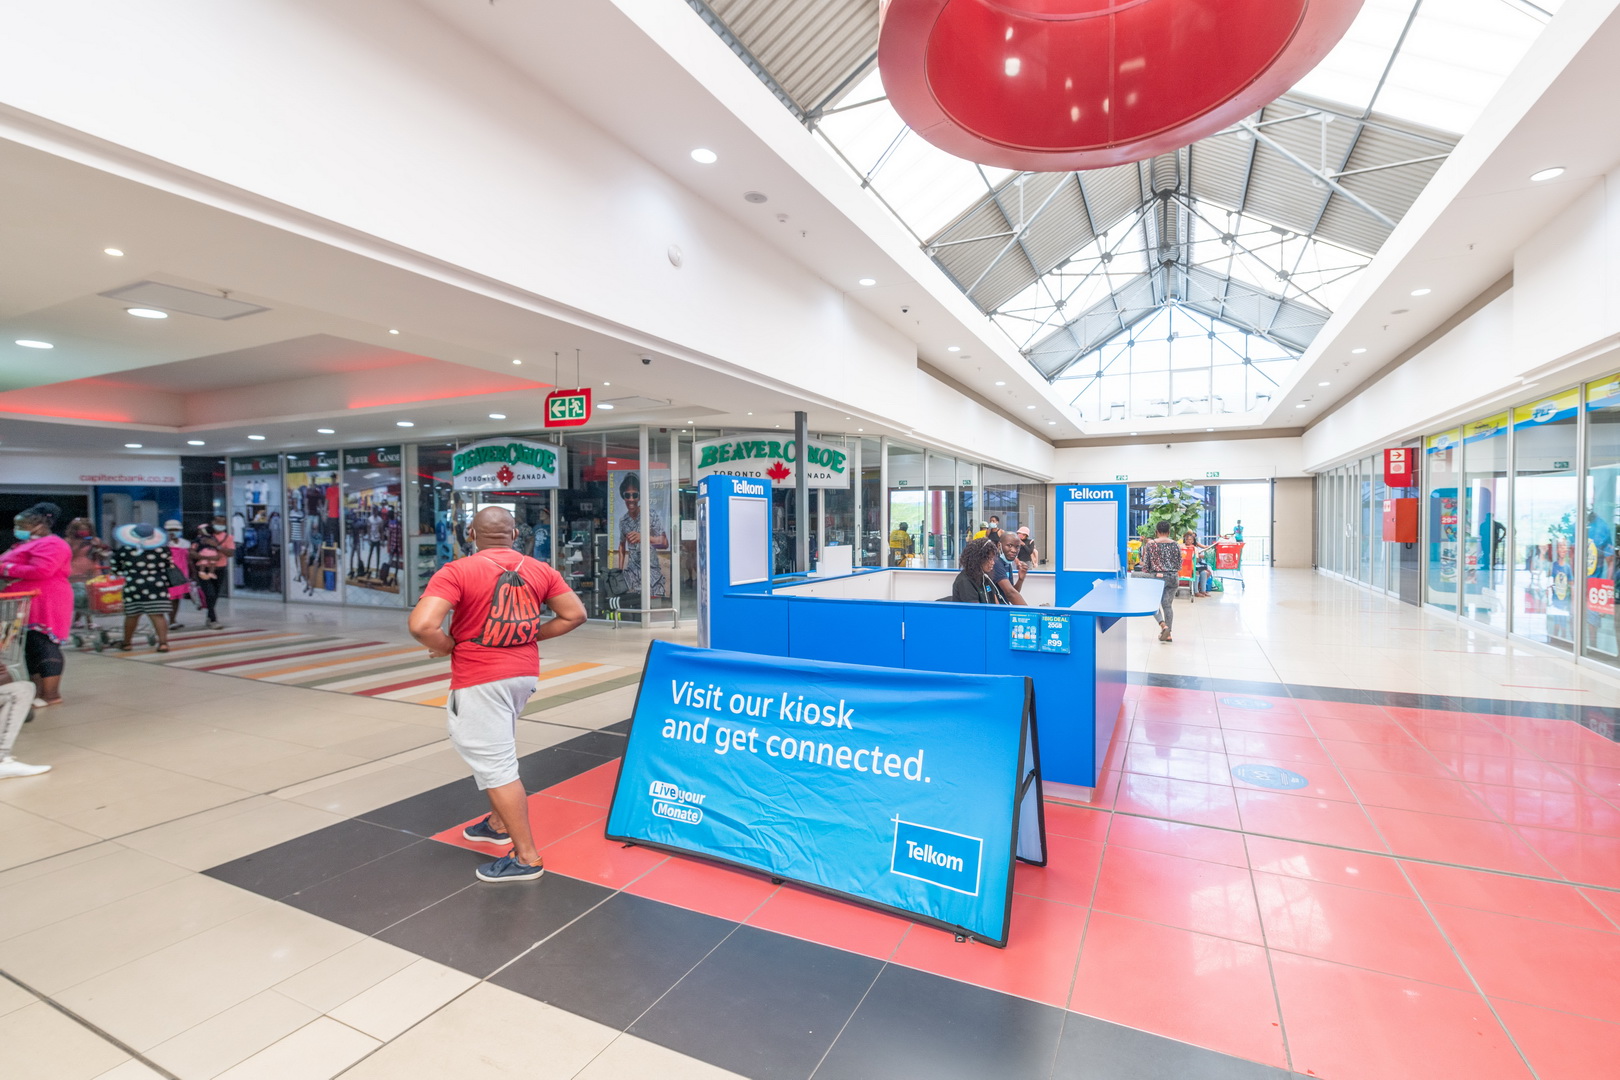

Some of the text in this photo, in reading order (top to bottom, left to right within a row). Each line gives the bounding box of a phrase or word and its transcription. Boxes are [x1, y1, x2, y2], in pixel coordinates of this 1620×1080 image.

[289, 458, 310, 468] BEAVER
[346, 455, 369, 464] BEAVER
[453, 443, 557, 477] BEAVER CANOE
[697, 440, 847, 474] BEAVER CNOE
[233, 462, 253, 471] BEAVER
[714, 470, 762, 478] TORONTO
[731, 479, 764, 495] Telkom
[1069, 488, 1114, 499] Telkom
[1588, 587, 1608, 605] 69
[482, 618, 540, 647] WISE
[1047, 639, 1062, 647] R99
[671, 679, 854, 730] Visit our kiosk
[662, 717, 931, 783] and get connected.
[652, 782, 706, 805] Live your
[657, 803, 699, 822] Monate
[906, 840, 964, 873] Telkom
